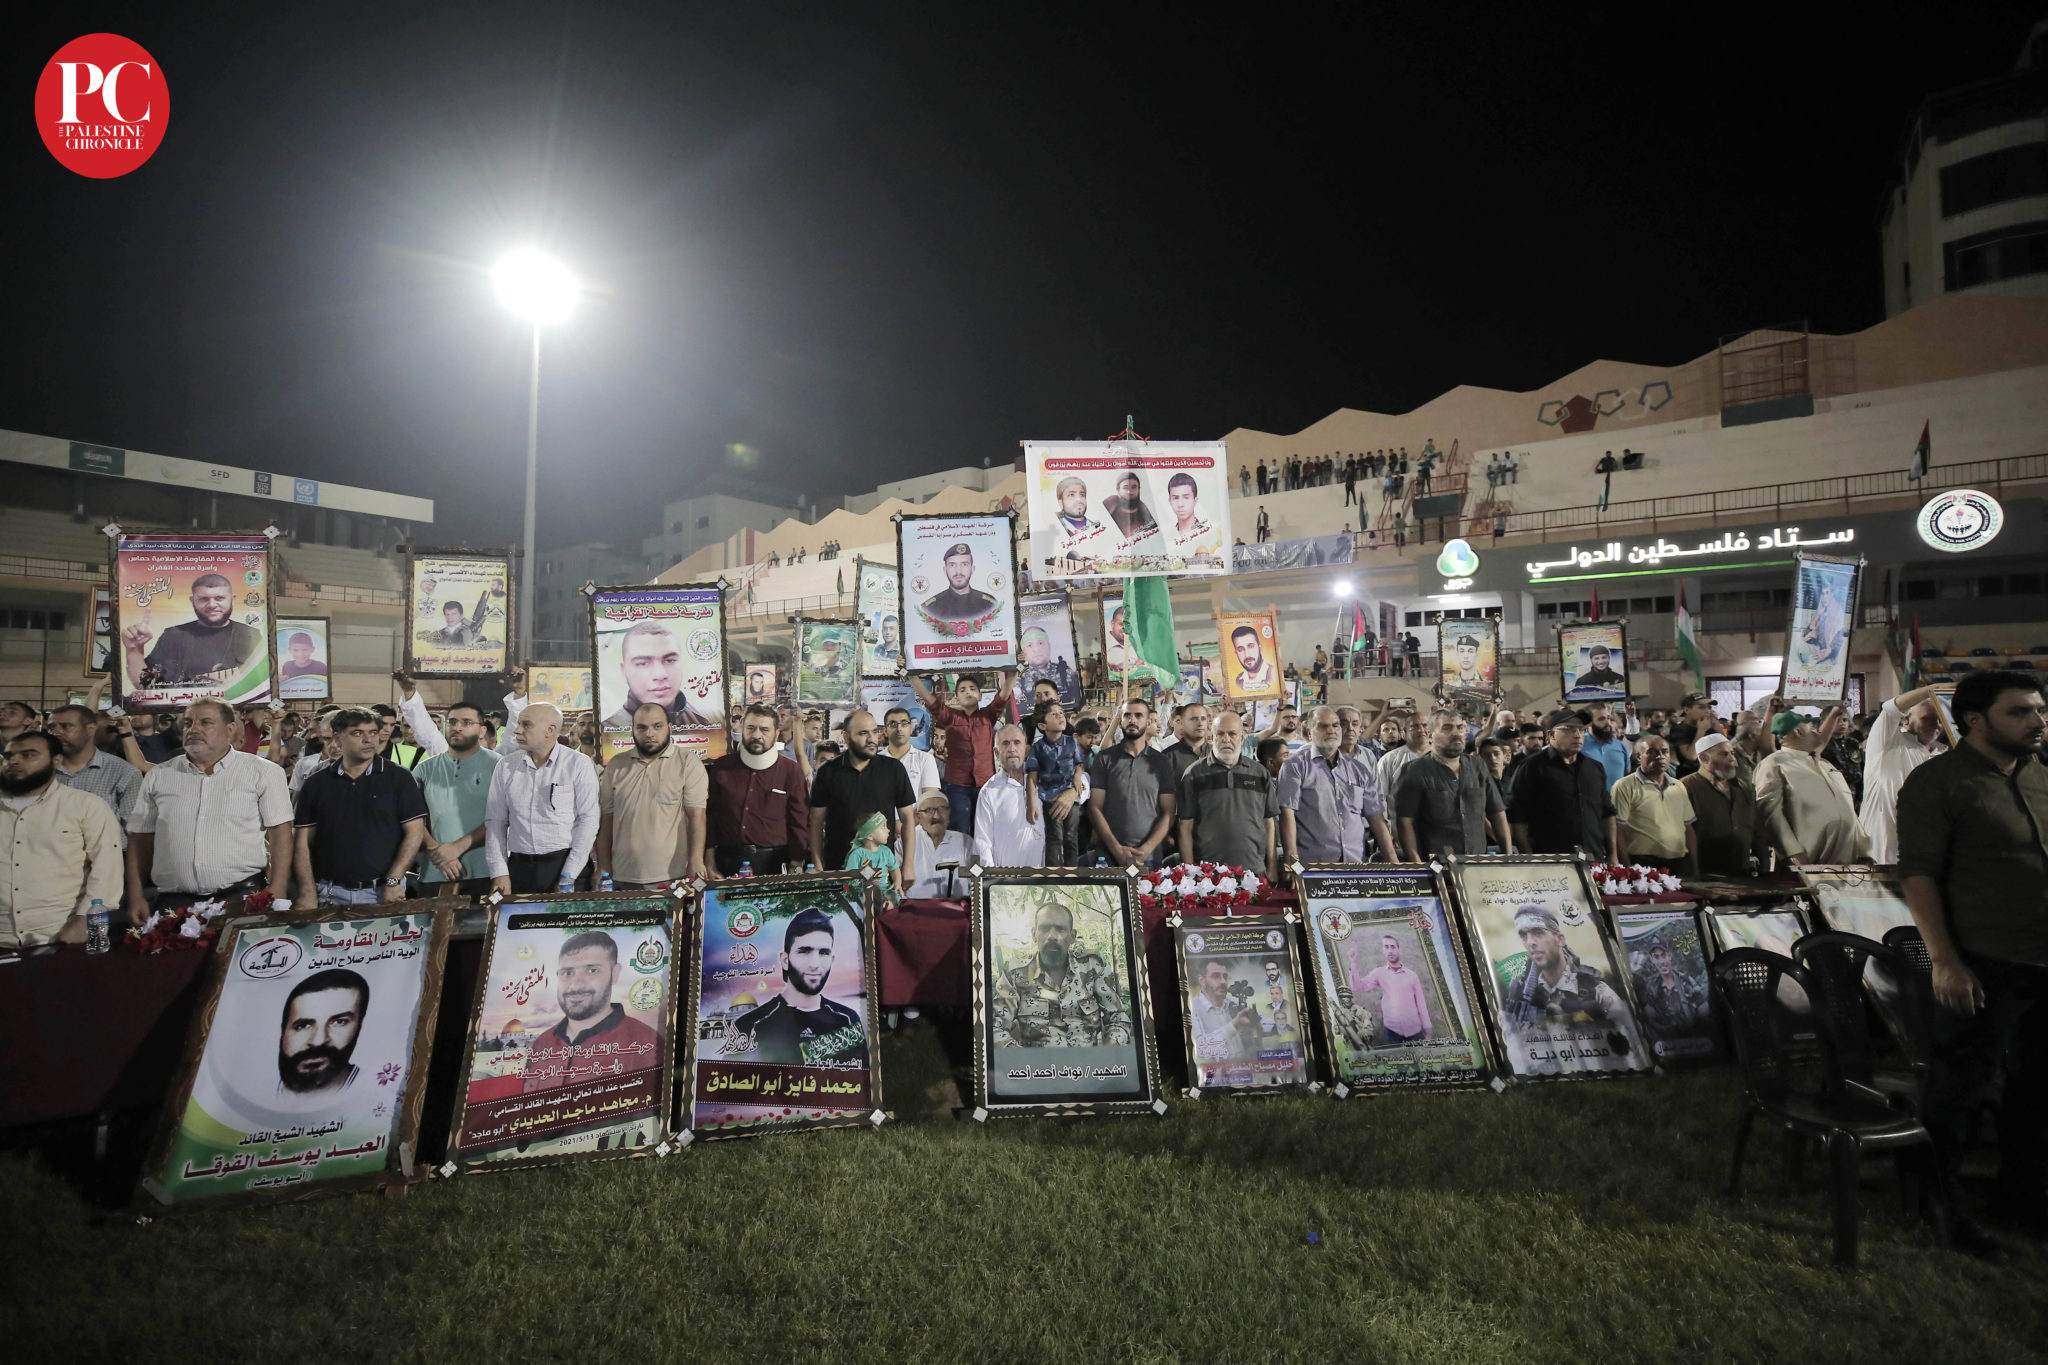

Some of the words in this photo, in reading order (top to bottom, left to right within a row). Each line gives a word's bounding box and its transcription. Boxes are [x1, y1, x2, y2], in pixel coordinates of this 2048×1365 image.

[210, 469, 230, 479] SFD
[1758, 527, 1855, 549] ستاد
[1628, 531, 1750, 564] فلسطين
[184, 555, 215, 563] المقاومة
[216, 555, 236, 563] حركة
[1526, 542, 1621, 579] الدولي
[920, 646, 934, 654] الله
[936, 646, 952, 655] نصر
[954, 645, 973, 655] غازي
[974, 645, 1003, 653] حسين
[1359, 878, 1384, 886] الإسلامي
[1310, 887, 1336, 897] الرضوان
[1336, 888, 1360, 897] كتيبة
[1366, 886, 1398, 897] القدس
[1399, 886, 1433, 897] سرايا
[313, 932, 378, 952] المقاومة
[379, 926, 425, 947] لجان
[307, 958, 337, 970] الدين
[338, 956, 364, 967] صلاح
[367, 949, 396, 964] الناصر
[526, 1046, 573, 1061] الإسلامية
[575, 1044, 612, 1058] المقاومة
[612, 1041, 655, 1055] حركة
[1530, 1048, 1558, 1062] دية
[1560, 1045, 1576, 1062] أبو
[1579, 1047, 1610, 1058] محمد
[489, 1050, 524, 1065] حماس
[516, 1065, 556, 1080] الوحدة
[557, 1064, 592, 1078] مسجد
[593, 1058, 624, 1074] وأسرة
[1007, 1065, 1031, 1079] أحمد
[1032, 1063, 1056, 1079] أحمد
[1058, 1065, 1083, 1080] نواف
[1092, 1065, 1128, 1081] الشهيد
[592, 1083, 604, 1095] الله
[605, 1084, 618, 1092] عند
[706, 1071, 760, 1093] الصادق
[762, 1071, 782, 1096] أبو
[784, 1073, 817, 1097] فايز
[820, 1078, 862, 1094] محمد
[524, 1097, 545, 1109] القائد
[546, 1093, 572, 1105] الشهيد
[599, 1096, 639, 1110] مجاهد
[493, 1102, 524, 1118] القسامي
[562, 1103, 596, 1119] ماجد
[509, 1109, 560, 1133] الحديدي
[273, 1128, 305, 1144] الشيخ
[307, 1121, 343, 1139] الشهيد
[239, 1131, 271, 1146] القائد
[559, 1133, 594, 1147] 2021/5/13
[326, 1135, 386, 1158] العبد
[257, 1148, 321, 1167] يوسف
[183, 1153, 254, 1179] القوقا
